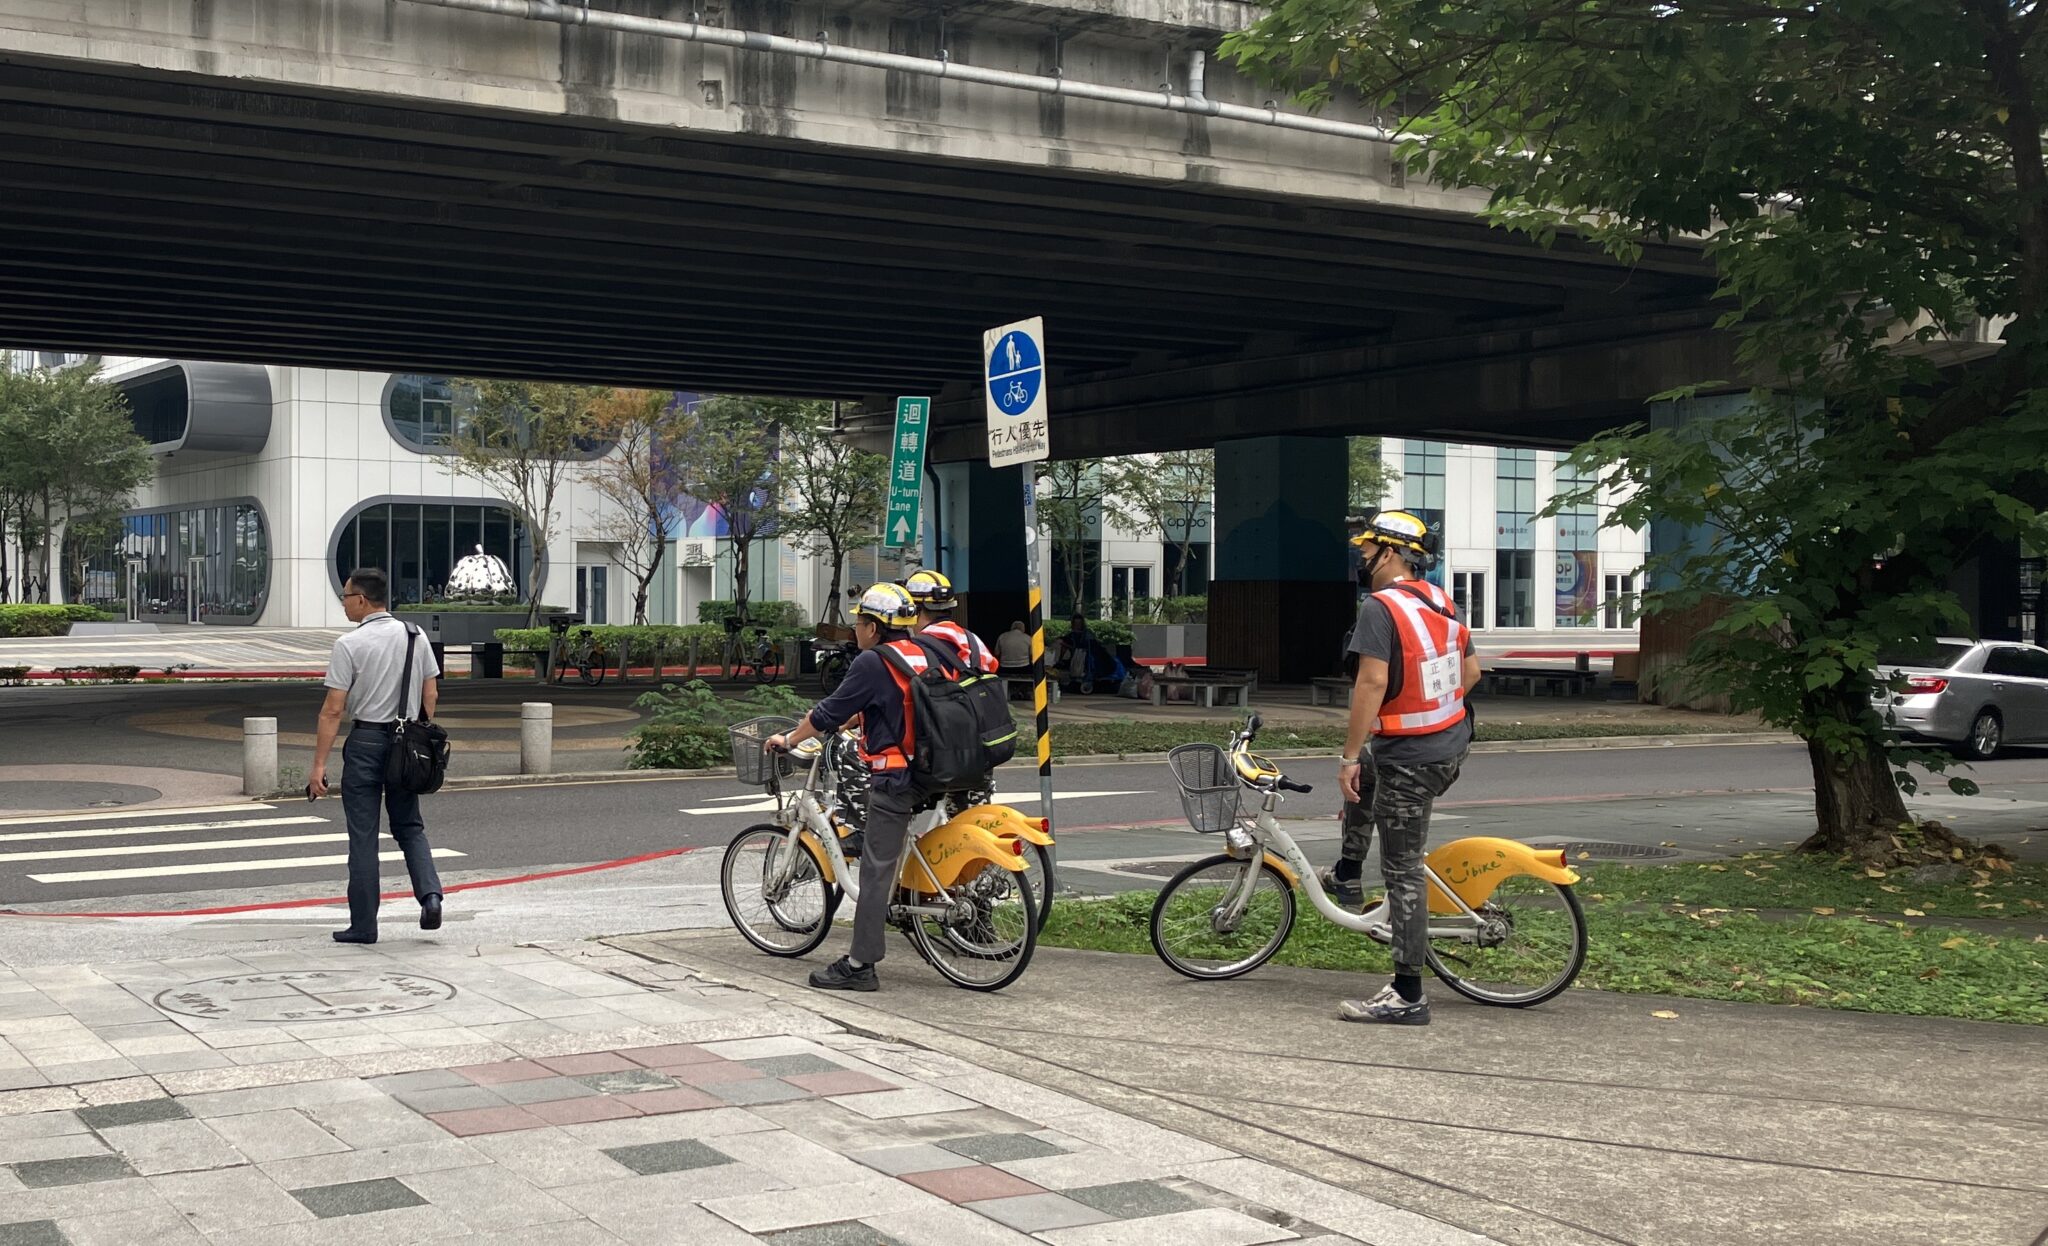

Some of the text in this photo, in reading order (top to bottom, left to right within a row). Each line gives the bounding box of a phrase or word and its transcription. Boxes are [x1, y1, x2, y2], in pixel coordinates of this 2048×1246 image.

[897, 403, 922, 482] 迴轉道
[991, 419, 1045, 446] 行人優先
[891, 485, 920, 498] U-turn
[889, 500, 912, 512] Lane
